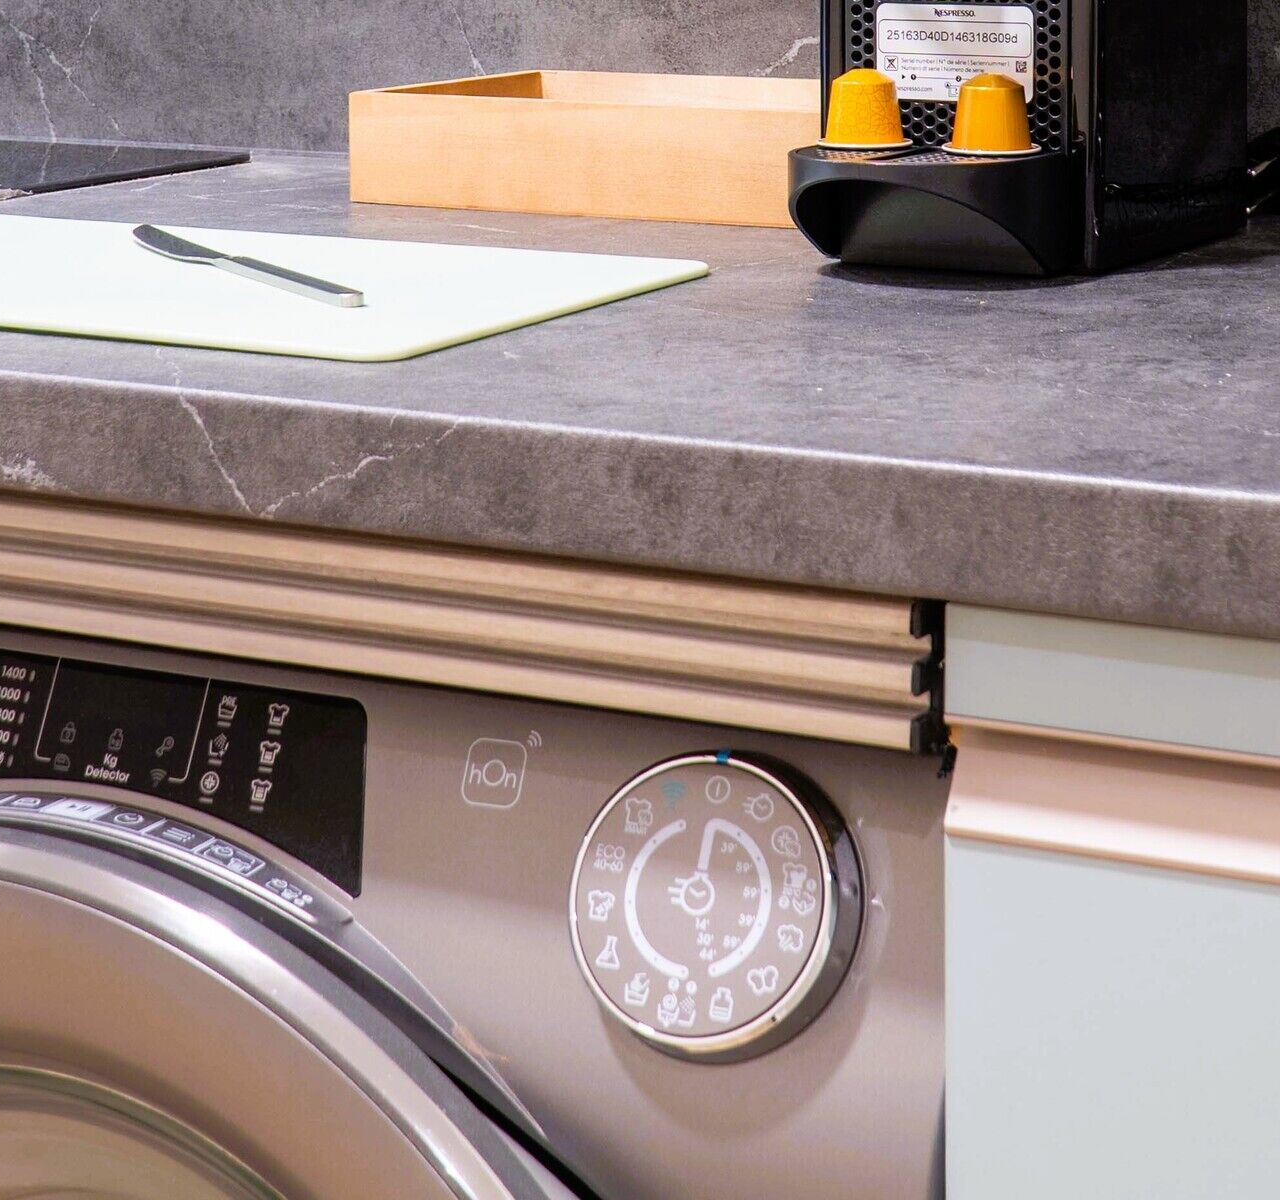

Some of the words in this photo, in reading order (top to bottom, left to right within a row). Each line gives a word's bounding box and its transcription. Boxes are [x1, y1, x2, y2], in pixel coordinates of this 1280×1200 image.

[1, 664, 27, 681] 1400
[103, 753, 118, 768] Kg
[84, 764, 130, 782] Detector
[468, 759, 517, 789] hOn
[595, 843, 626, 860] ECO
